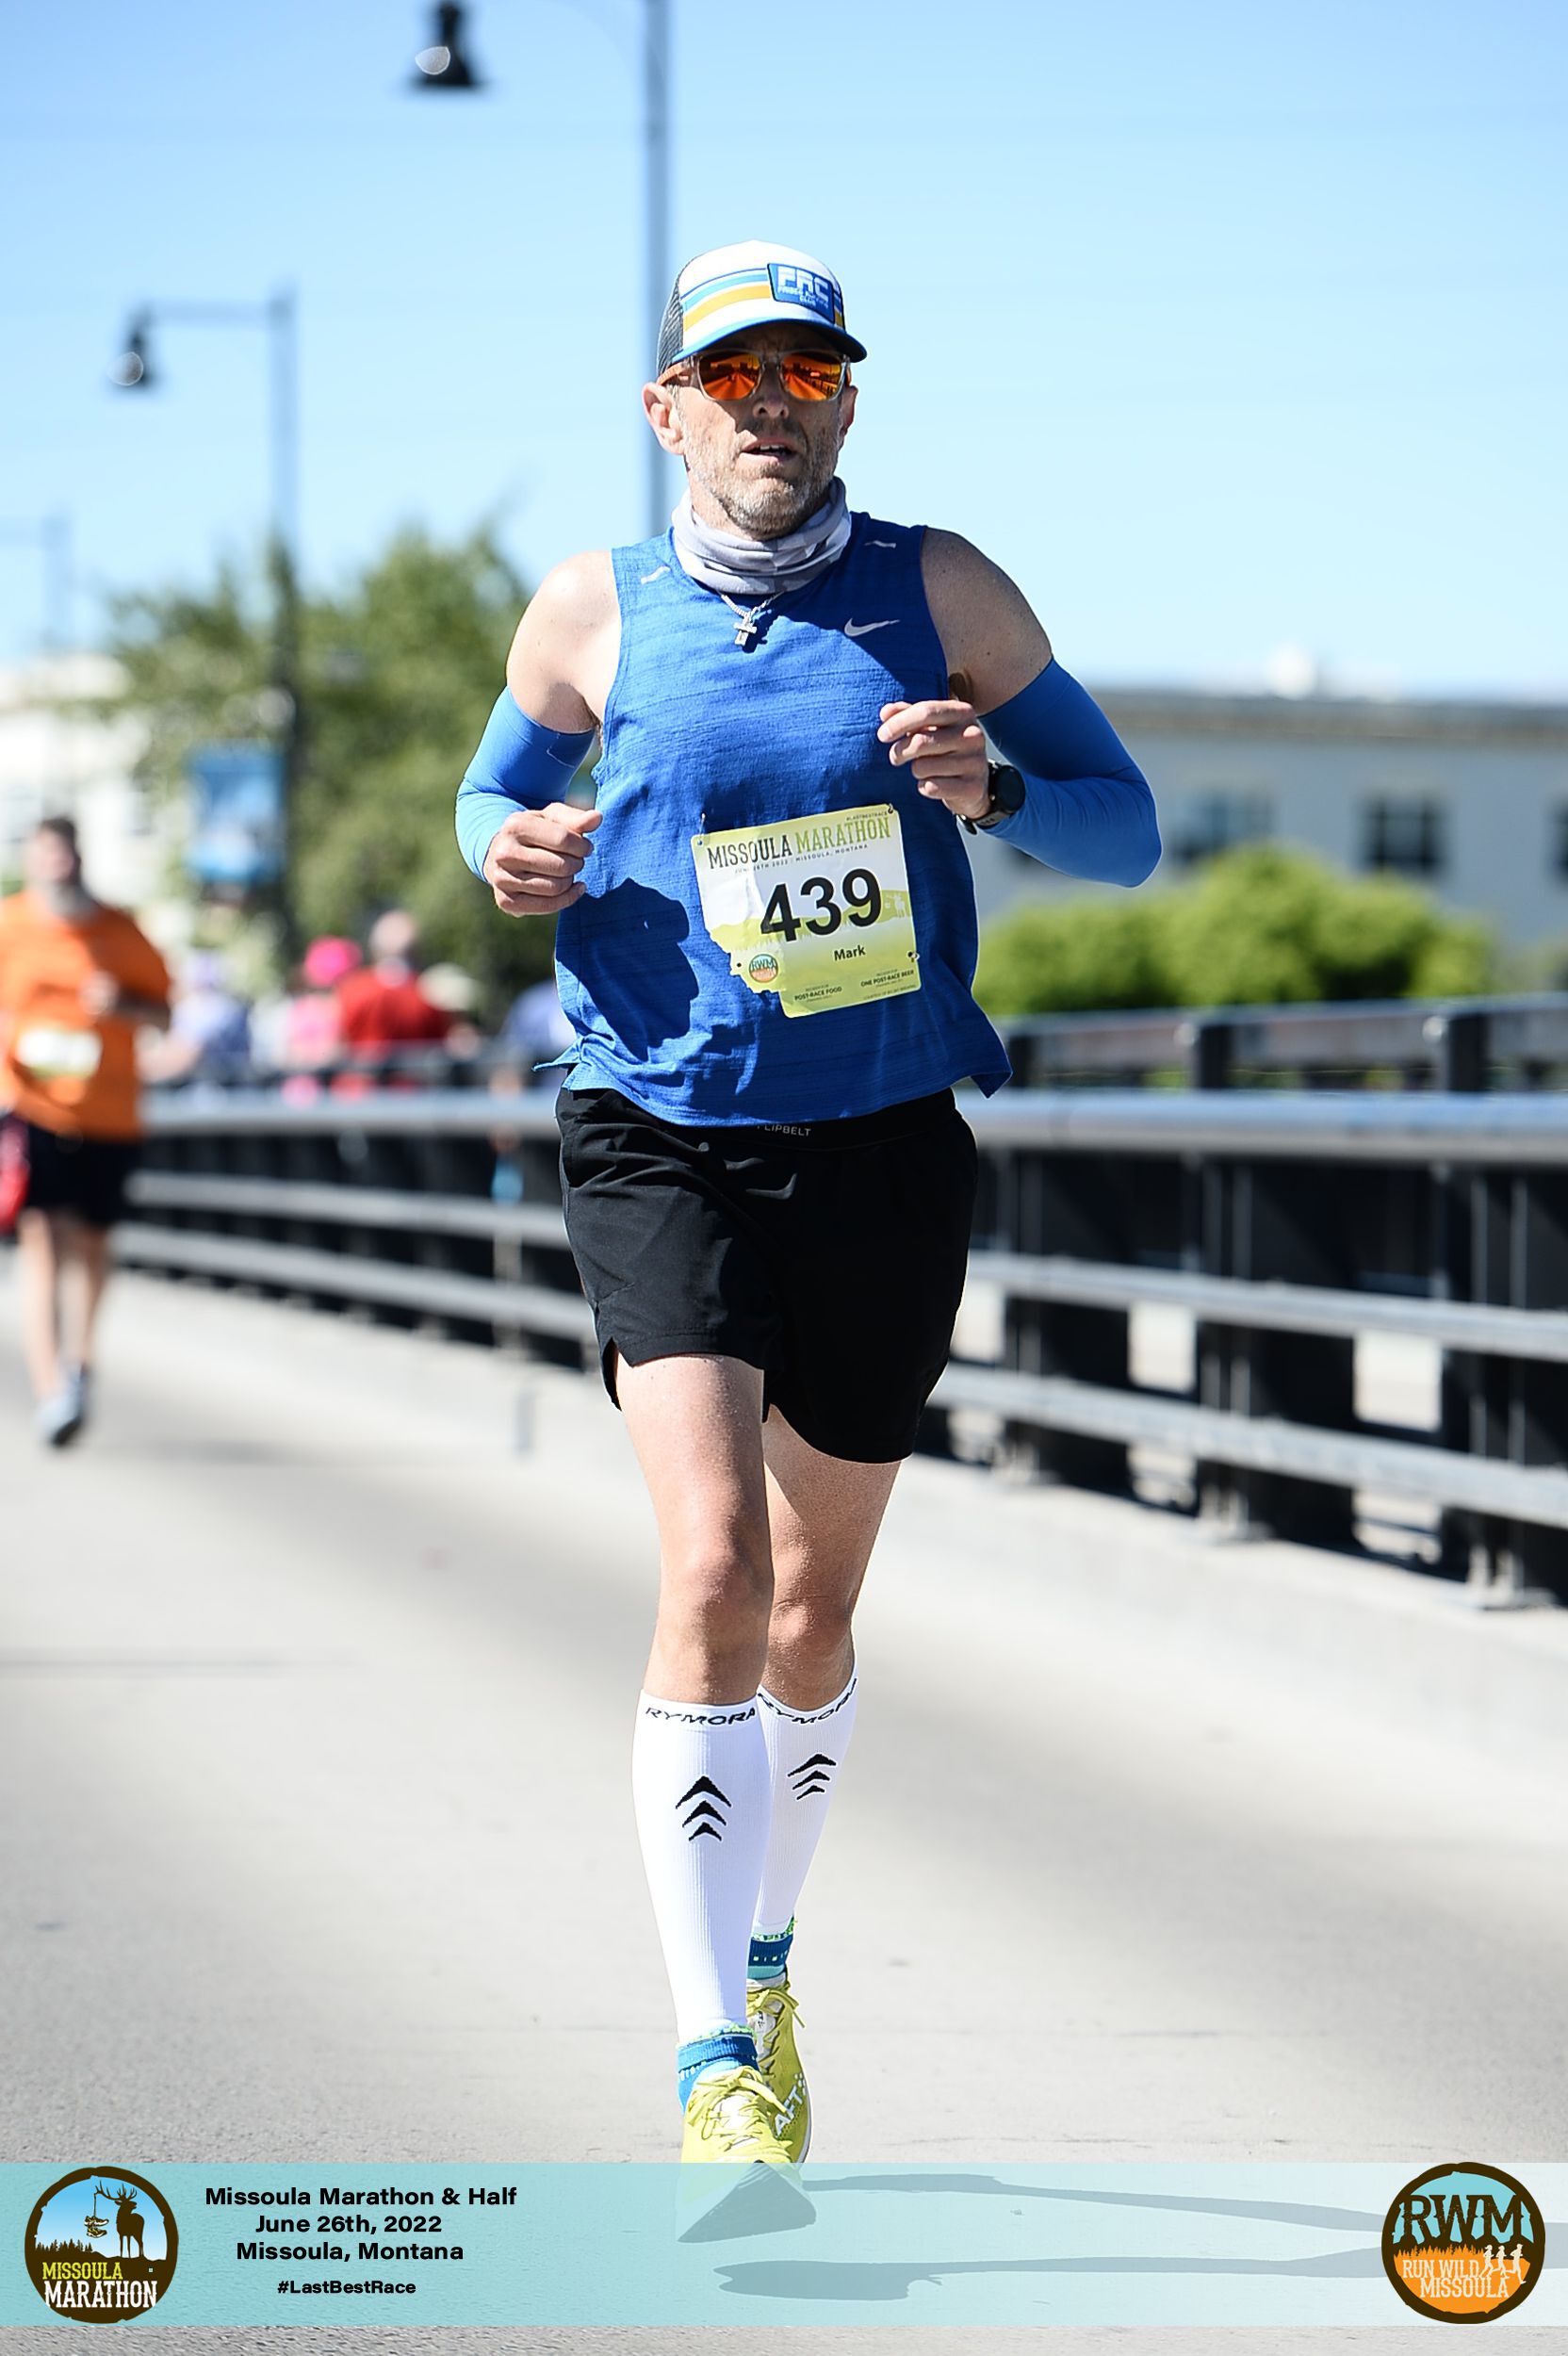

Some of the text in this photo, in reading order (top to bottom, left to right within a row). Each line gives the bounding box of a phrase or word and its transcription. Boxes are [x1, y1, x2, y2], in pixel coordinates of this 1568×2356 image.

[707, 817, 890, 869] MISSOULA MARATHON
[836, 844, 868, 854] MONTANA
[760, 868, 882, 941] 439
[834, 944, 866, 961] Mark
